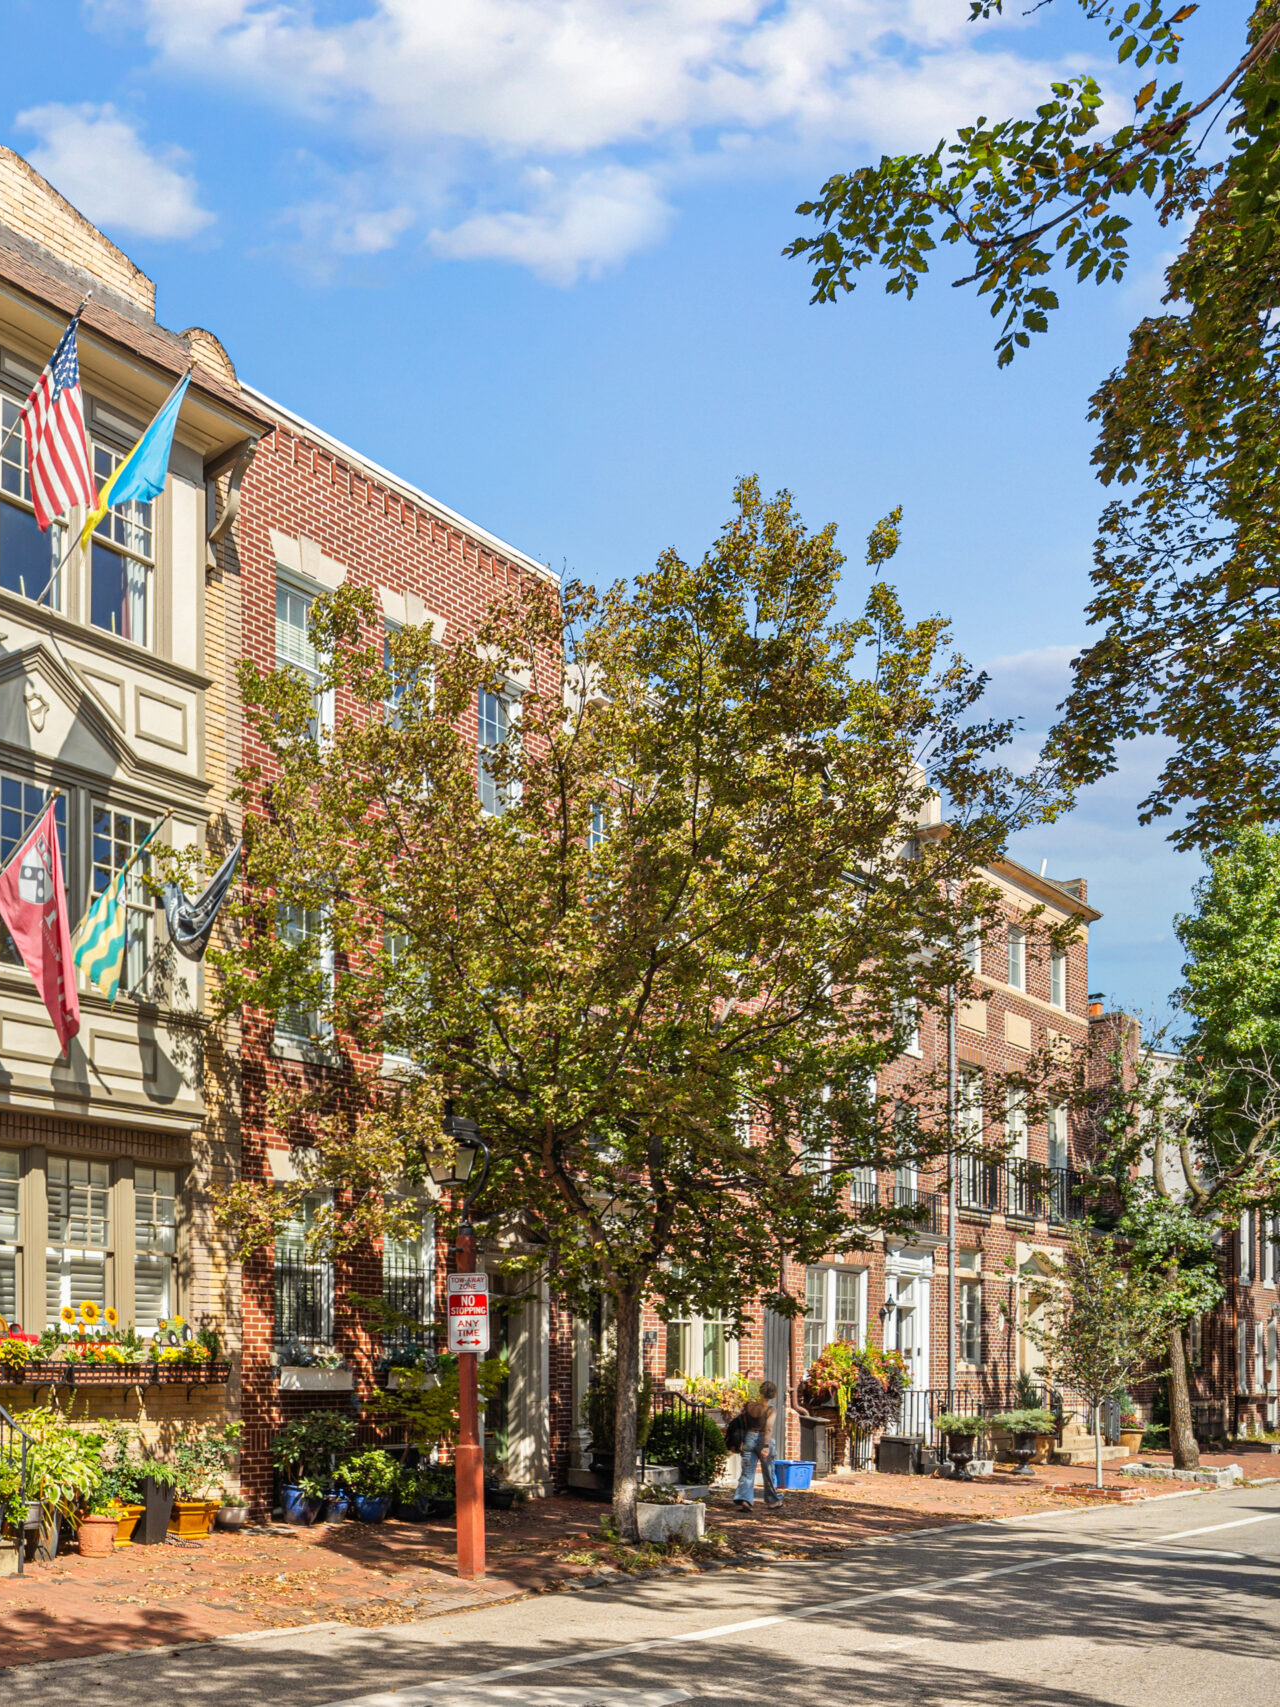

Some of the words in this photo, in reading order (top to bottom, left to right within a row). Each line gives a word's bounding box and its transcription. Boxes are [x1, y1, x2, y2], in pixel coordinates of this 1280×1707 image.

[461, 1295, 475, 1306] NO
[451, 1306, 486, 1315] STOPPING
[457, 1320, 480, 1328] ANY
[457, 1329, 480, 1337] TIME
